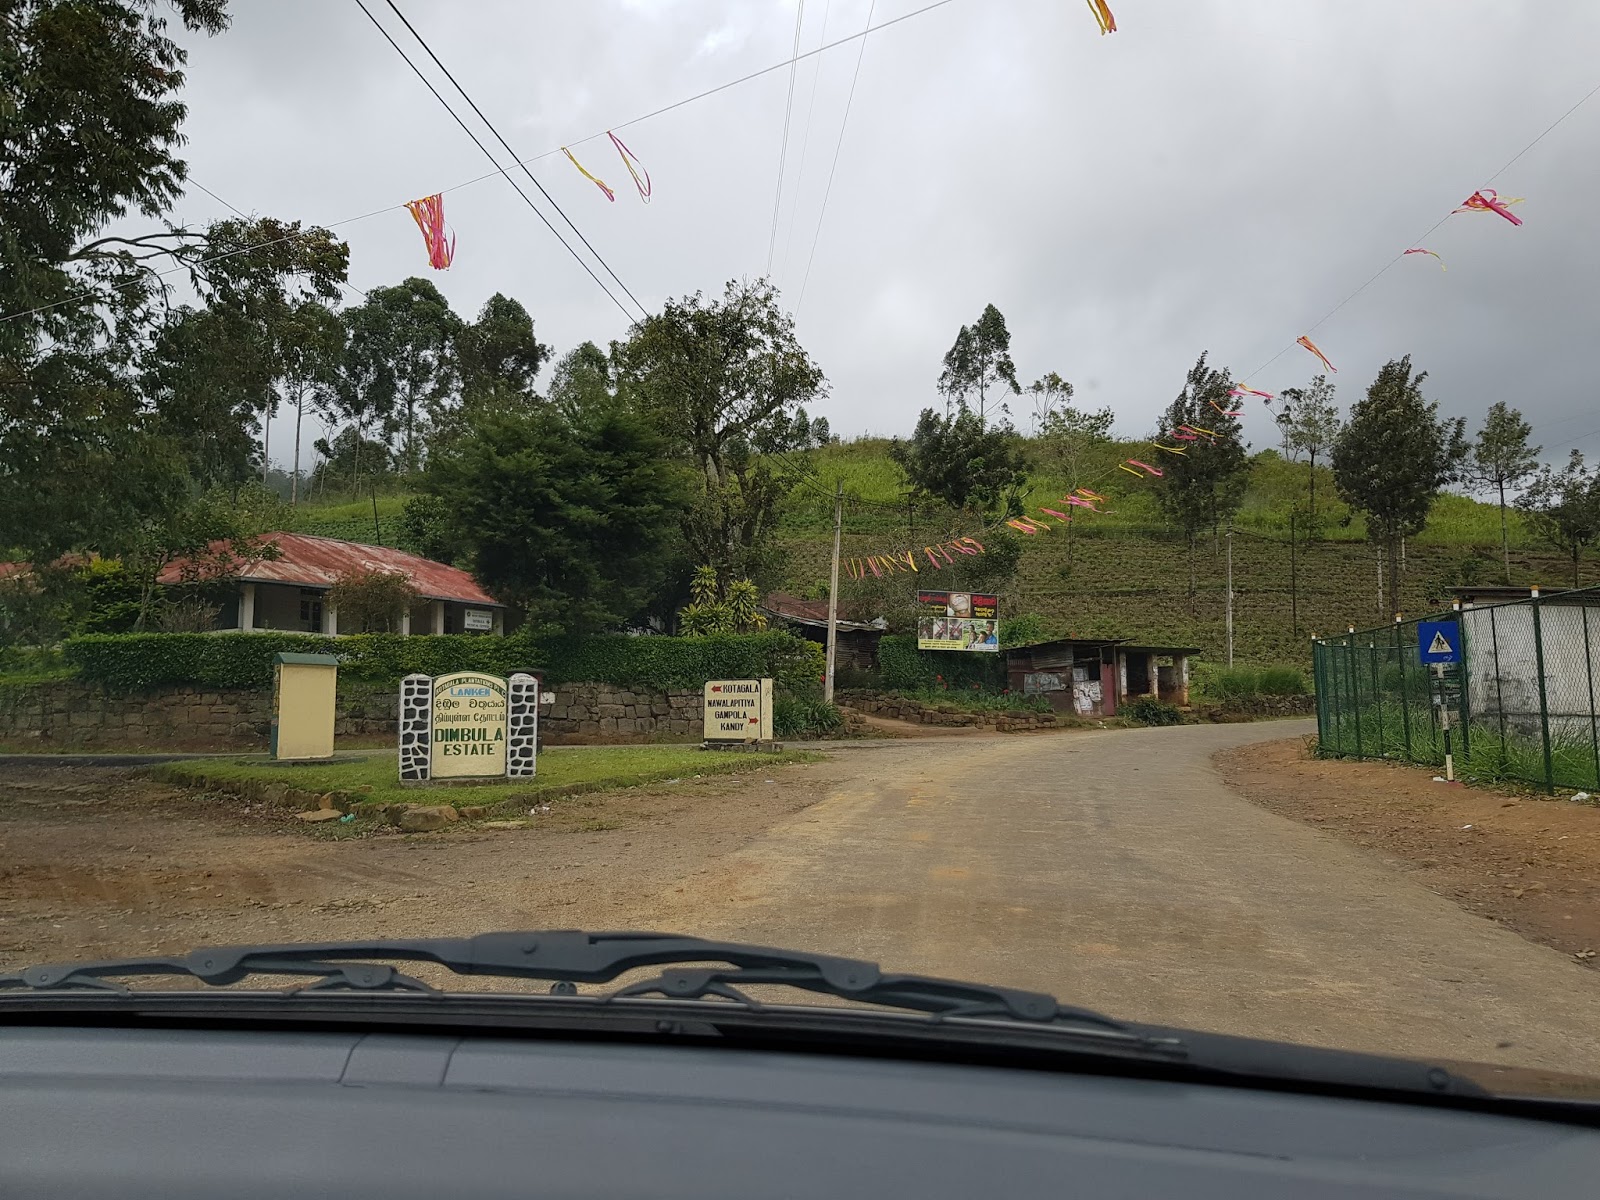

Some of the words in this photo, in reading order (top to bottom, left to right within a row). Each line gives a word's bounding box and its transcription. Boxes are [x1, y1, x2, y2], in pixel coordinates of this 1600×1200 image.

[723, 684, 759, 693] KOTAGALA
[708, 699, 755, 707] NAWALAPITIYA
[715, 711, 747, 719] GAMPOLA
[434, 728, 504, 742] DIMBULA
[444, 743, 495, 756] ESTATE
